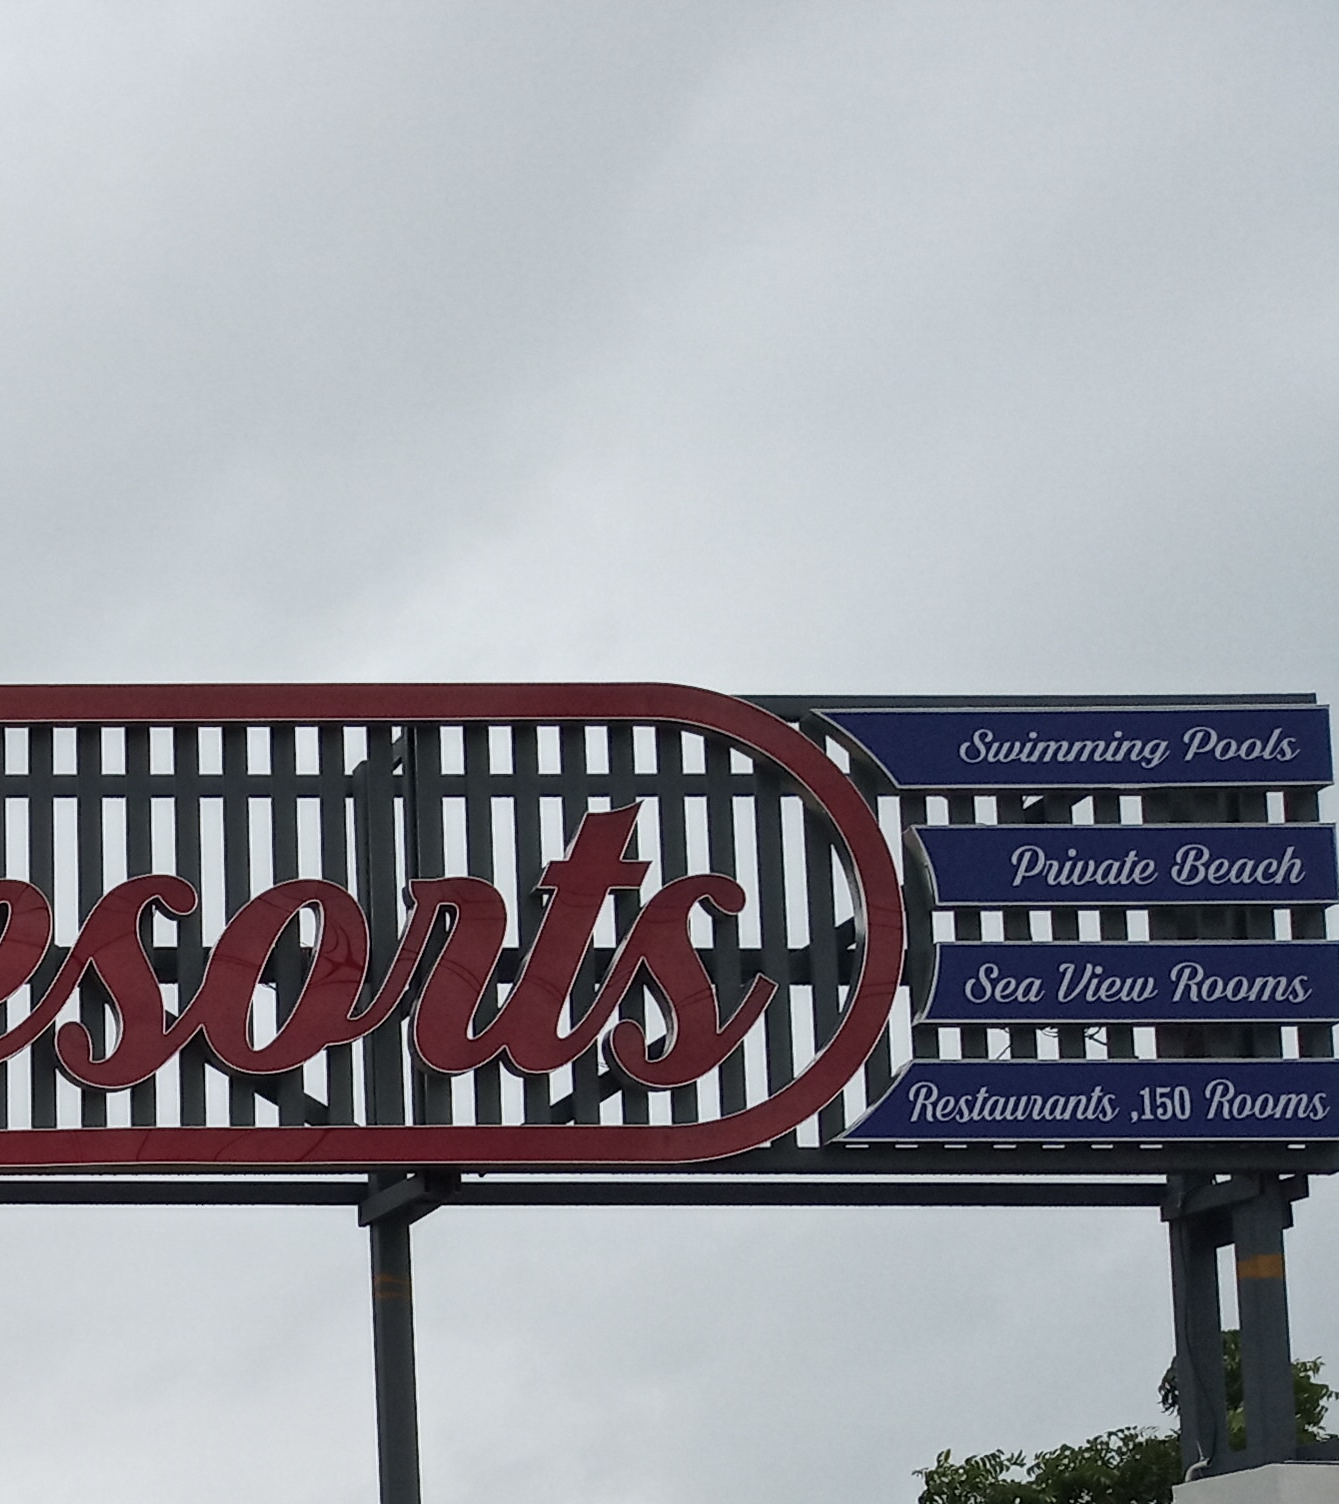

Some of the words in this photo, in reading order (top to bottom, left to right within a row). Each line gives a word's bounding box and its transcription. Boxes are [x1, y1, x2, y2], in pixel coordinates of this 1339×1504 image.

[959, 728, 1171, 769] Swimming
[1182, 726, 1301, 763] Pools
[1010, 845, 1159, 887] Private
[1170, 843, 1306, 885] Beach
[964, 963, 1046, 1004] Sea
[1057, 963, 1160, 1003] View
[1170, 962, 1313, 1004] Rooms
[908, 1081, 1121, 1124] Restaurants
[1204, 1079, 1331, 1122] Rooms
